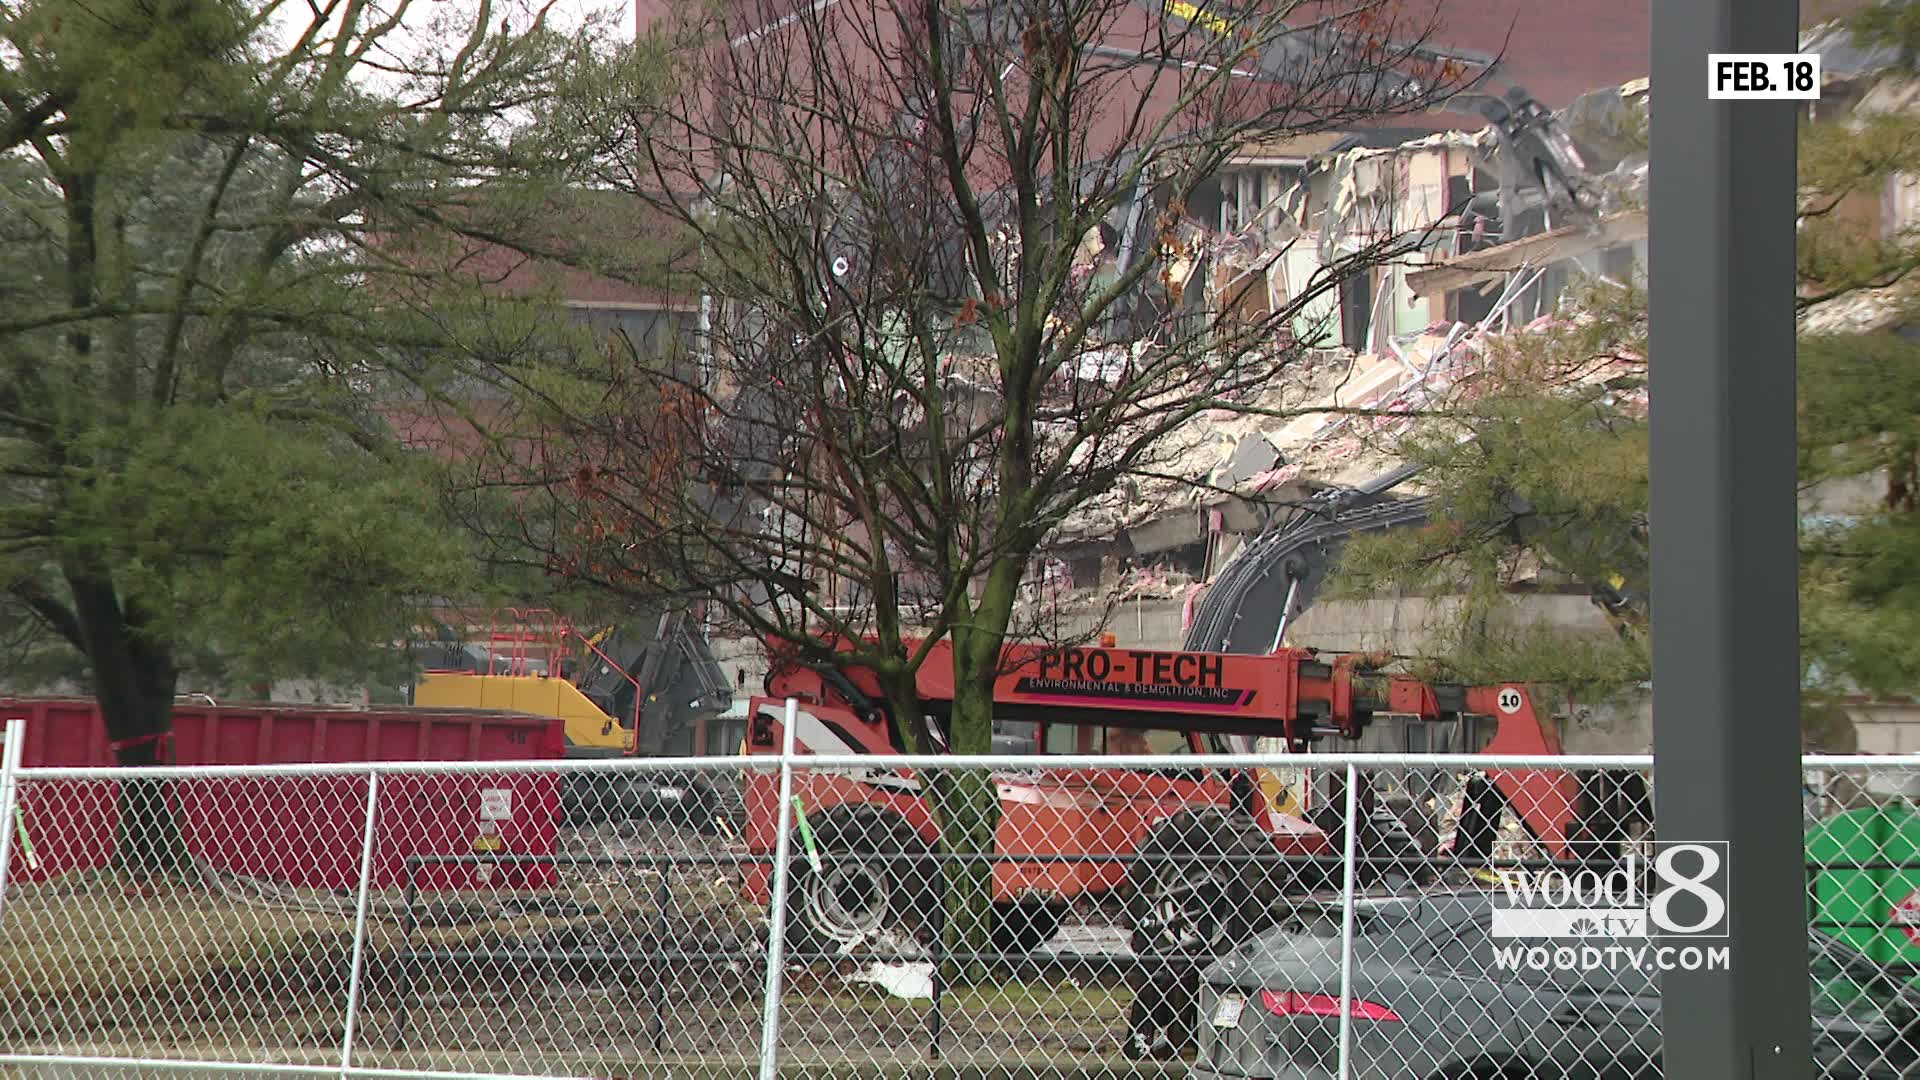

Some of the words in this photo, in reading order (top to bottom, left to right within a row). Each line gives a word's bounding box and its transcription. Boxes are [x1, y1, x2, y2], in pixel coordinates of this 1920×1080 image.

[1040, 651, 1222, 688] PRO-TECH
[1029, 678, 1120, 693] ENVIRONMENTAL
[1124, 684, 1132, 693] &
[1501, 694, 1519, 707] 10
